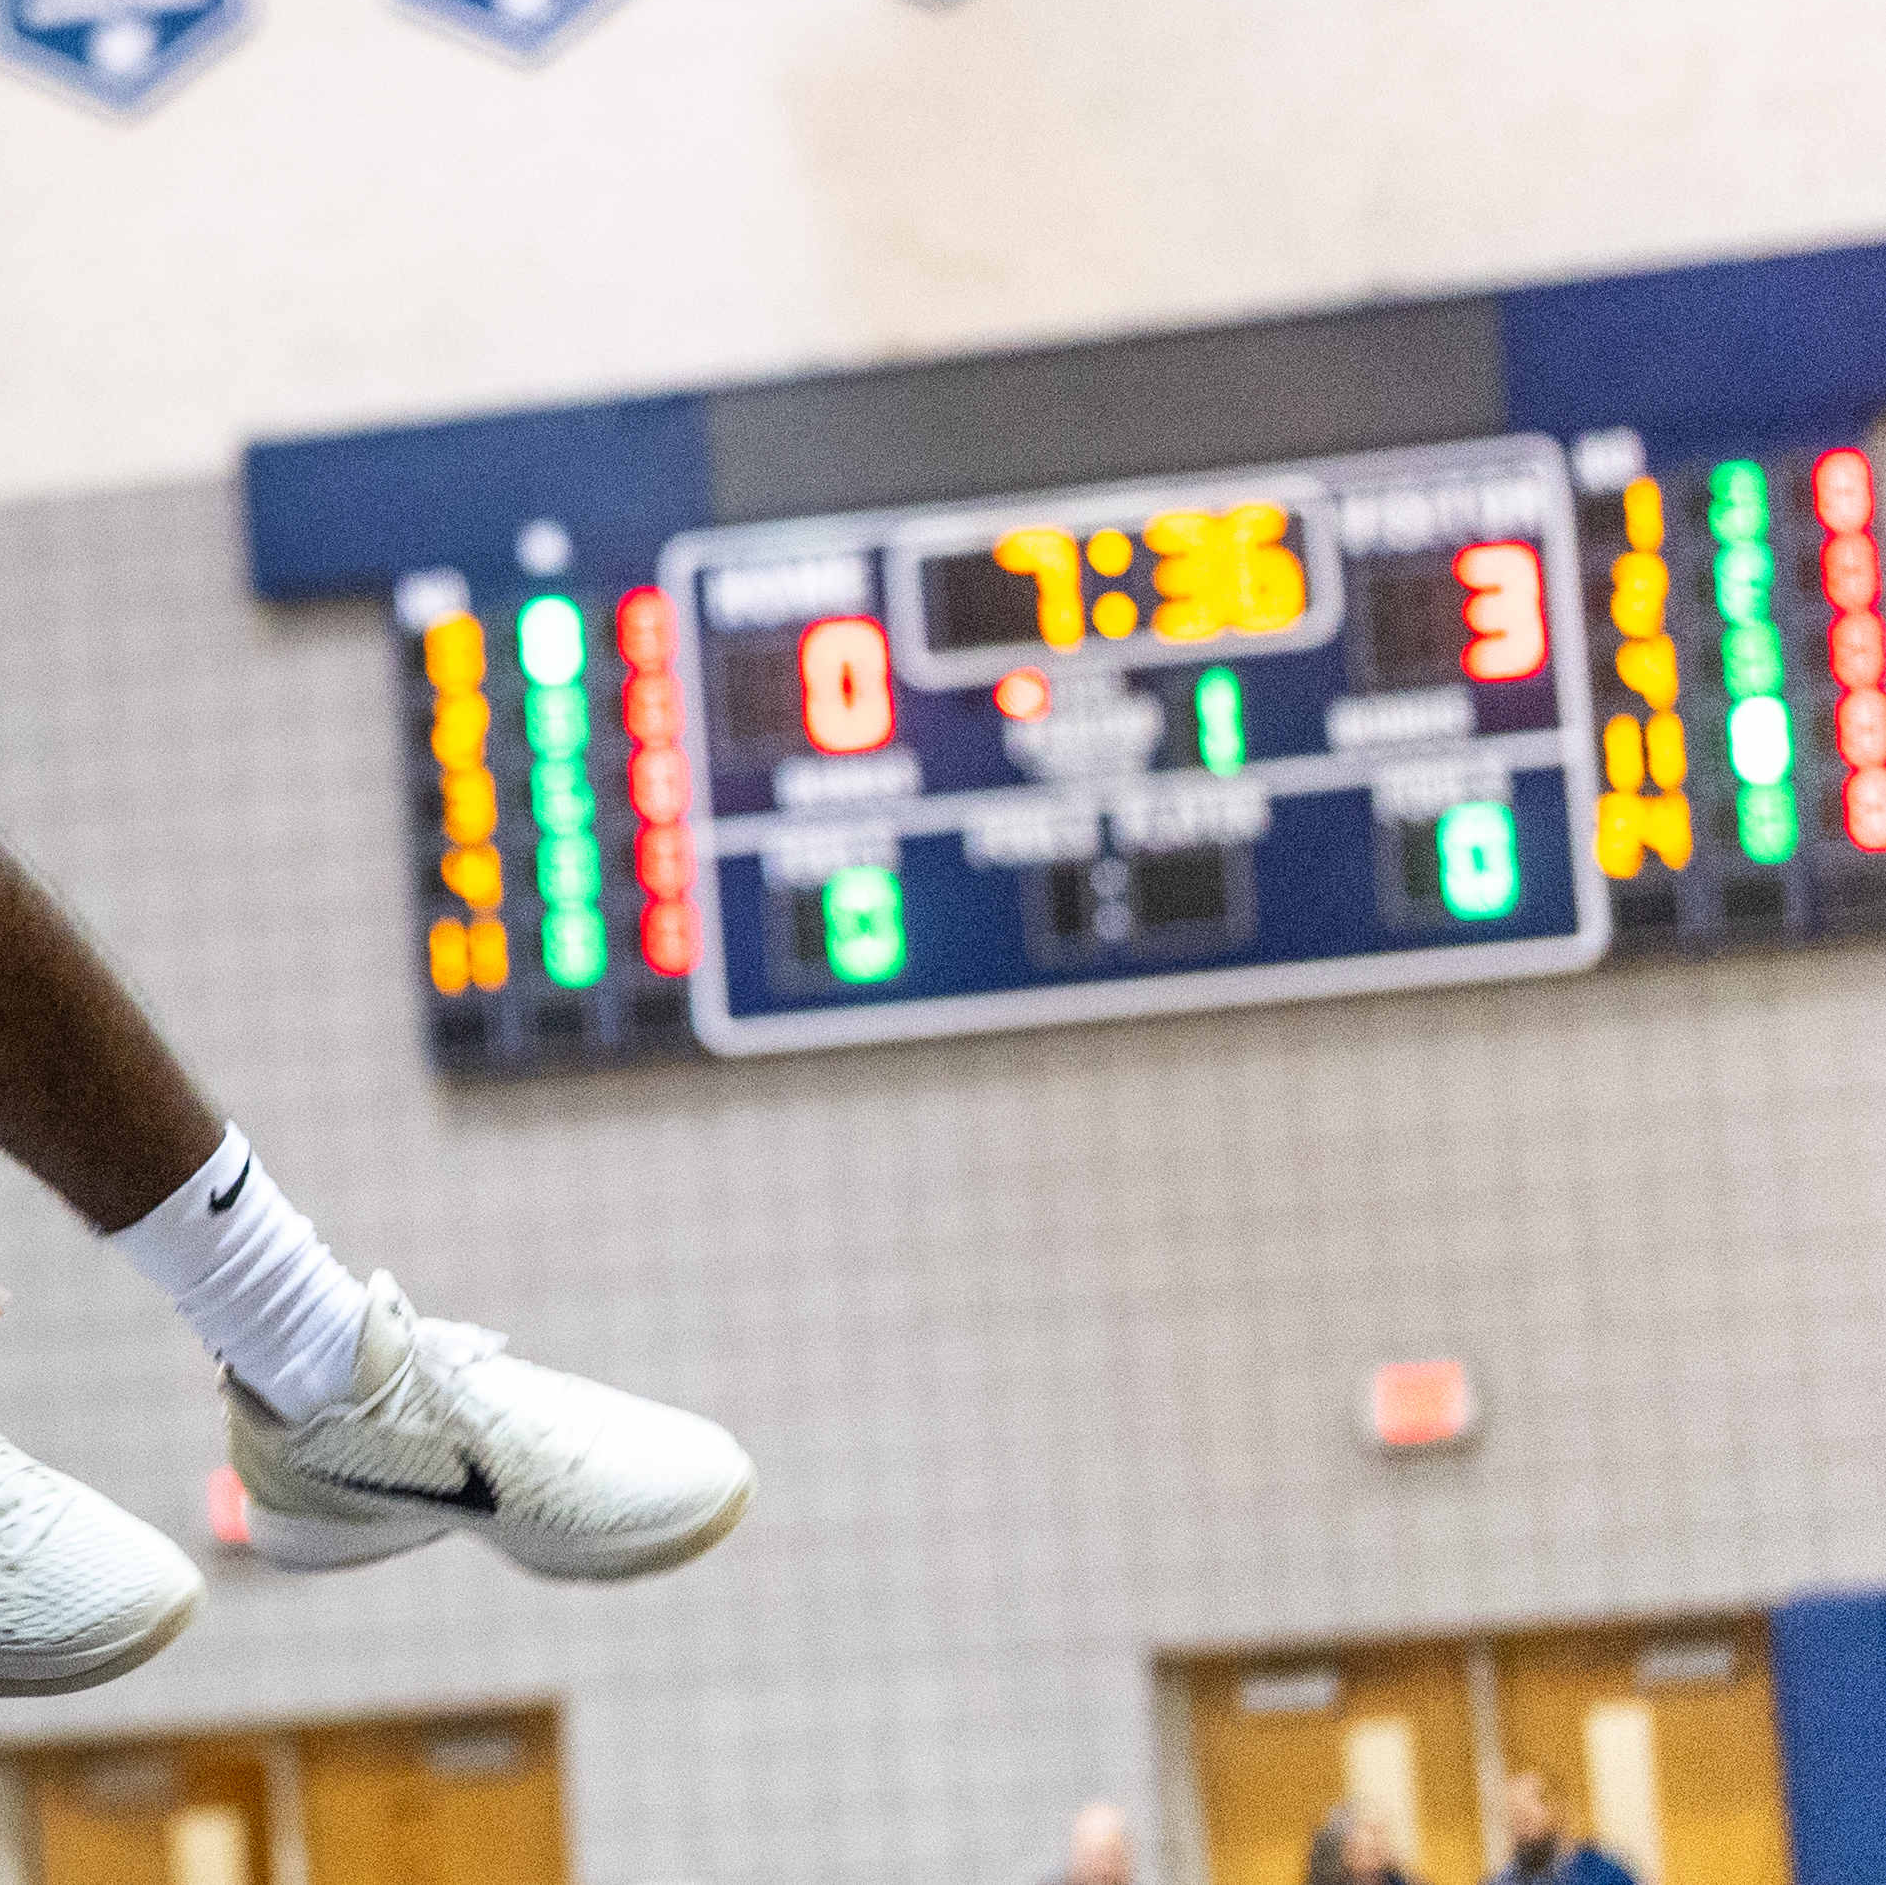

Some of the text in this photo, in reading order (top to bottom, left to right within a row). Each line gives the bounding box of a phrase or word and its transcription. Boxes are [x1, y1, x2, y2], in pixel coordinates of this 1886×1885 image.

[993, 501, 1307, 654] 7:36
[1452, 539, 1549, 683] 3
[798, 613, 896, 757] 0
[1193, 665, 1247, 776] 1
[1434, 800, 1523, 923] 0
